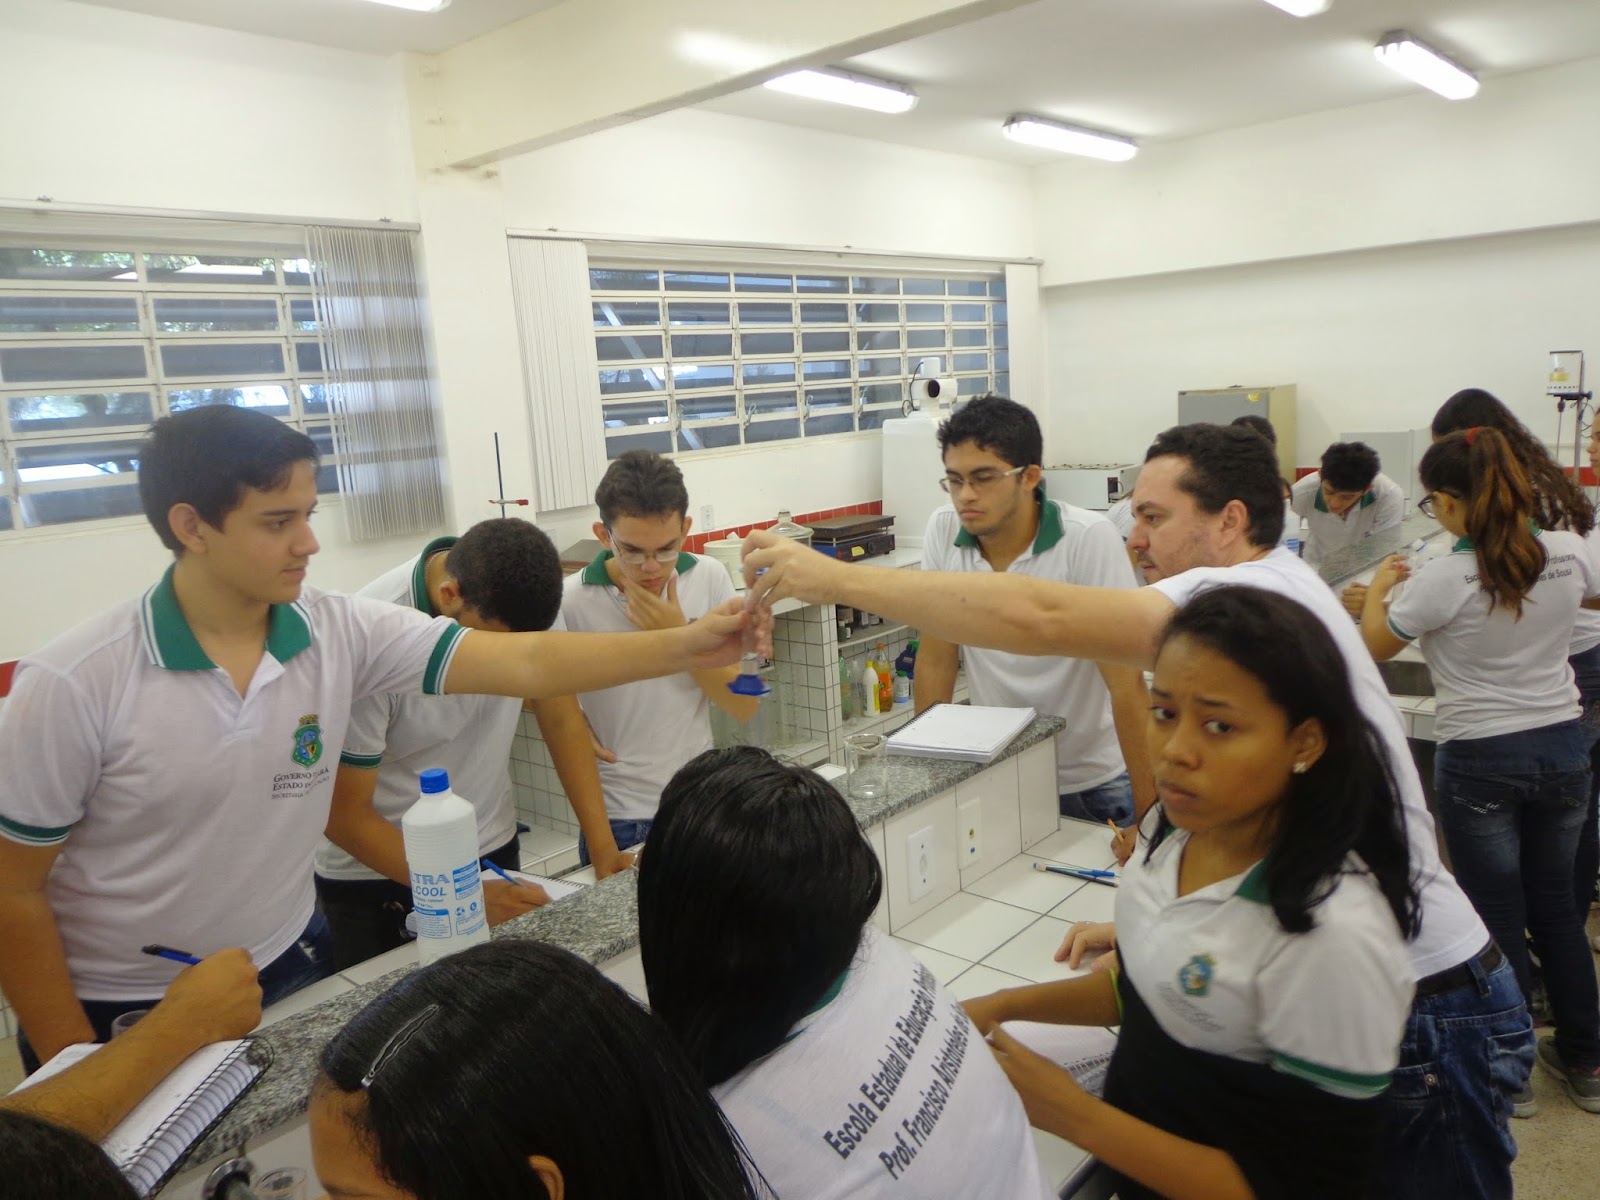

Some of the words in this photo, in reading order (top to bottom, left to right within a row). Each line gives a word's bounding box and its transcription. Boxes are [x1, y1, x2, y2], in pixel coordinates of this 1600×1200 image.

[895, 989, 937, 1046] Educação
[890, 1036, 915, 1060] de
[859, 1044, 909, 1112] Estadual
[822, 1102, 879, 1160] Escola
[878, 1131, 918, 1180] Prof.
[902, 1090, 950, 1148] Francisco
